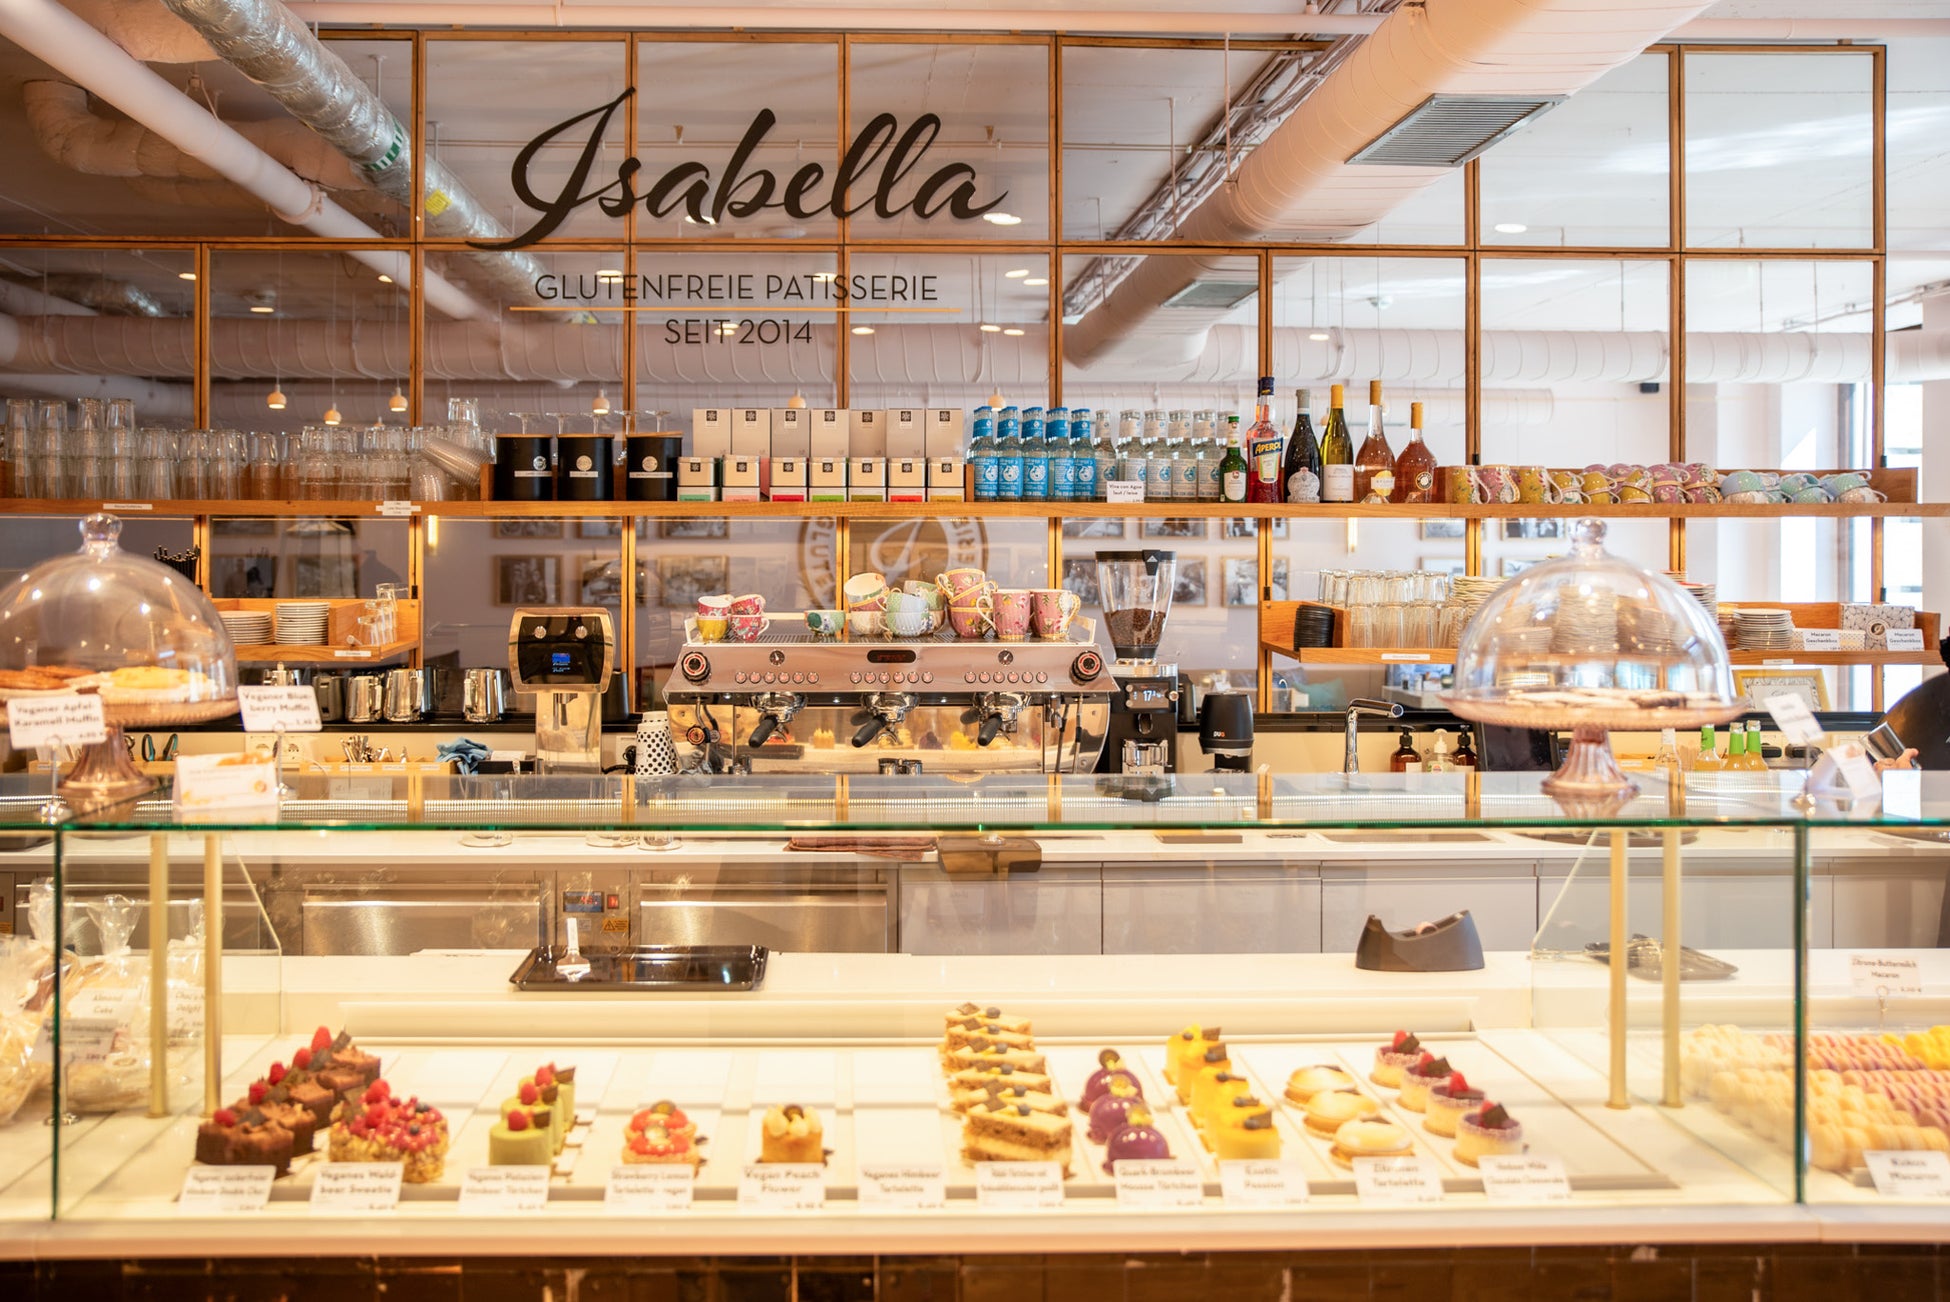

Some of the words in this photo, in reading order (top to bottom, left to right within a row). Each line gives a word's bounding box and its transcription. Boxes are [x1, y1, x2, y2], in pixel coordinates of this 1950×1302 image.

[465, 86, 1008, 250] Isabella
[535, 274, 754, 300] GLUTENFREIE
[766, 274, 938, 300] PATISSERIE
[664, 319, 734, 344] SEIT
[739, 319, 812, 344] 2014
[1255, 441, 1281, 455] APEROL
[243, 691, 283, 702] Veganer
[15, 704, 58, 714] Veganer
[280, 703, 310, 711] Muffin
[15, 717, 62, 726] Karamell
[66, 714, 99, 724] Muffin
[744, 1168, 780, 1181] Vegan
[785, 1169, 820, 1179] Peach
